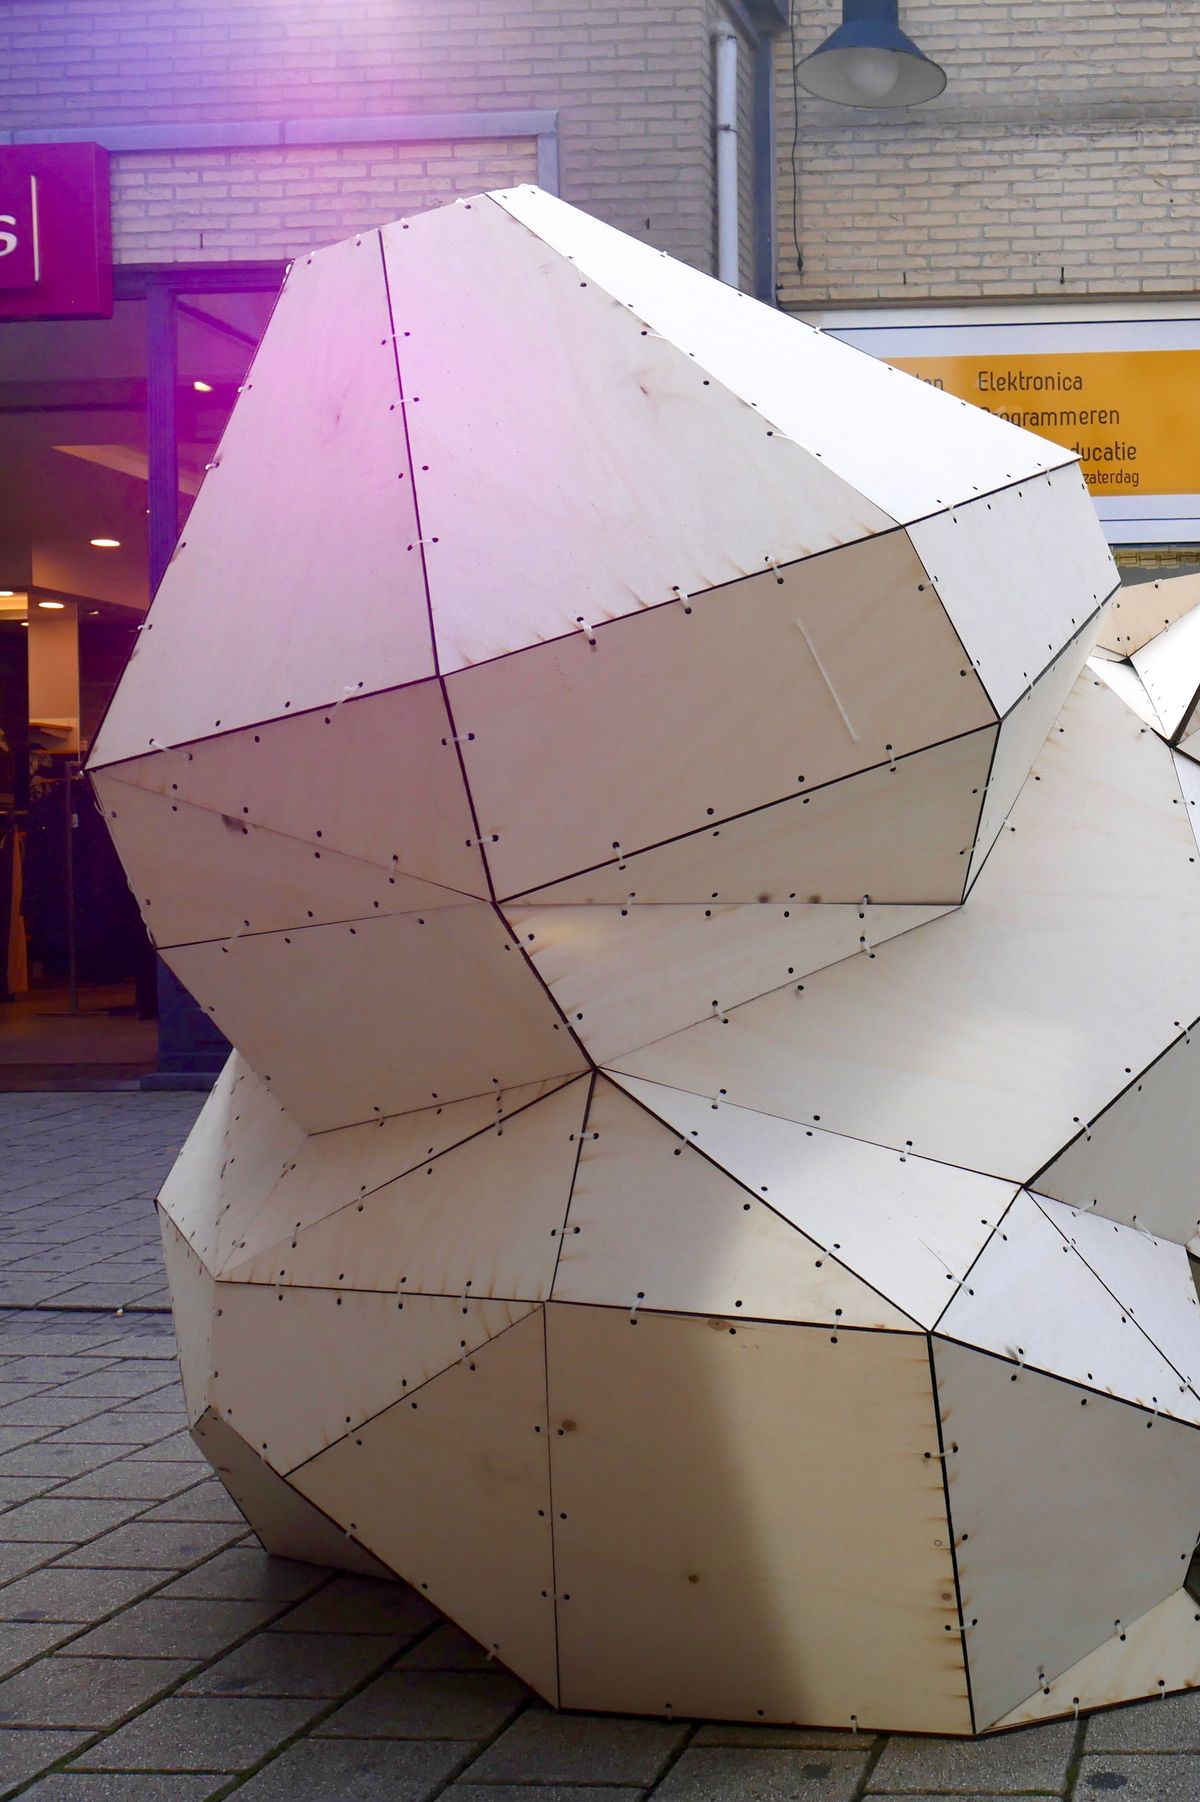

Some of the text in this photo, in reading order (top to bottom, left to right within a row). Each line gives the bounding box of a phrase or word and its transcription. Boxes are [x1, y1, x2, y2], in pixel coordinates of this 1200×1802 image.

[977, 371, 1084, 392] Elektronica
[980, 406, 1121, 428] ogrammeren
[1082, 468, 1140, 487] zaterdag
